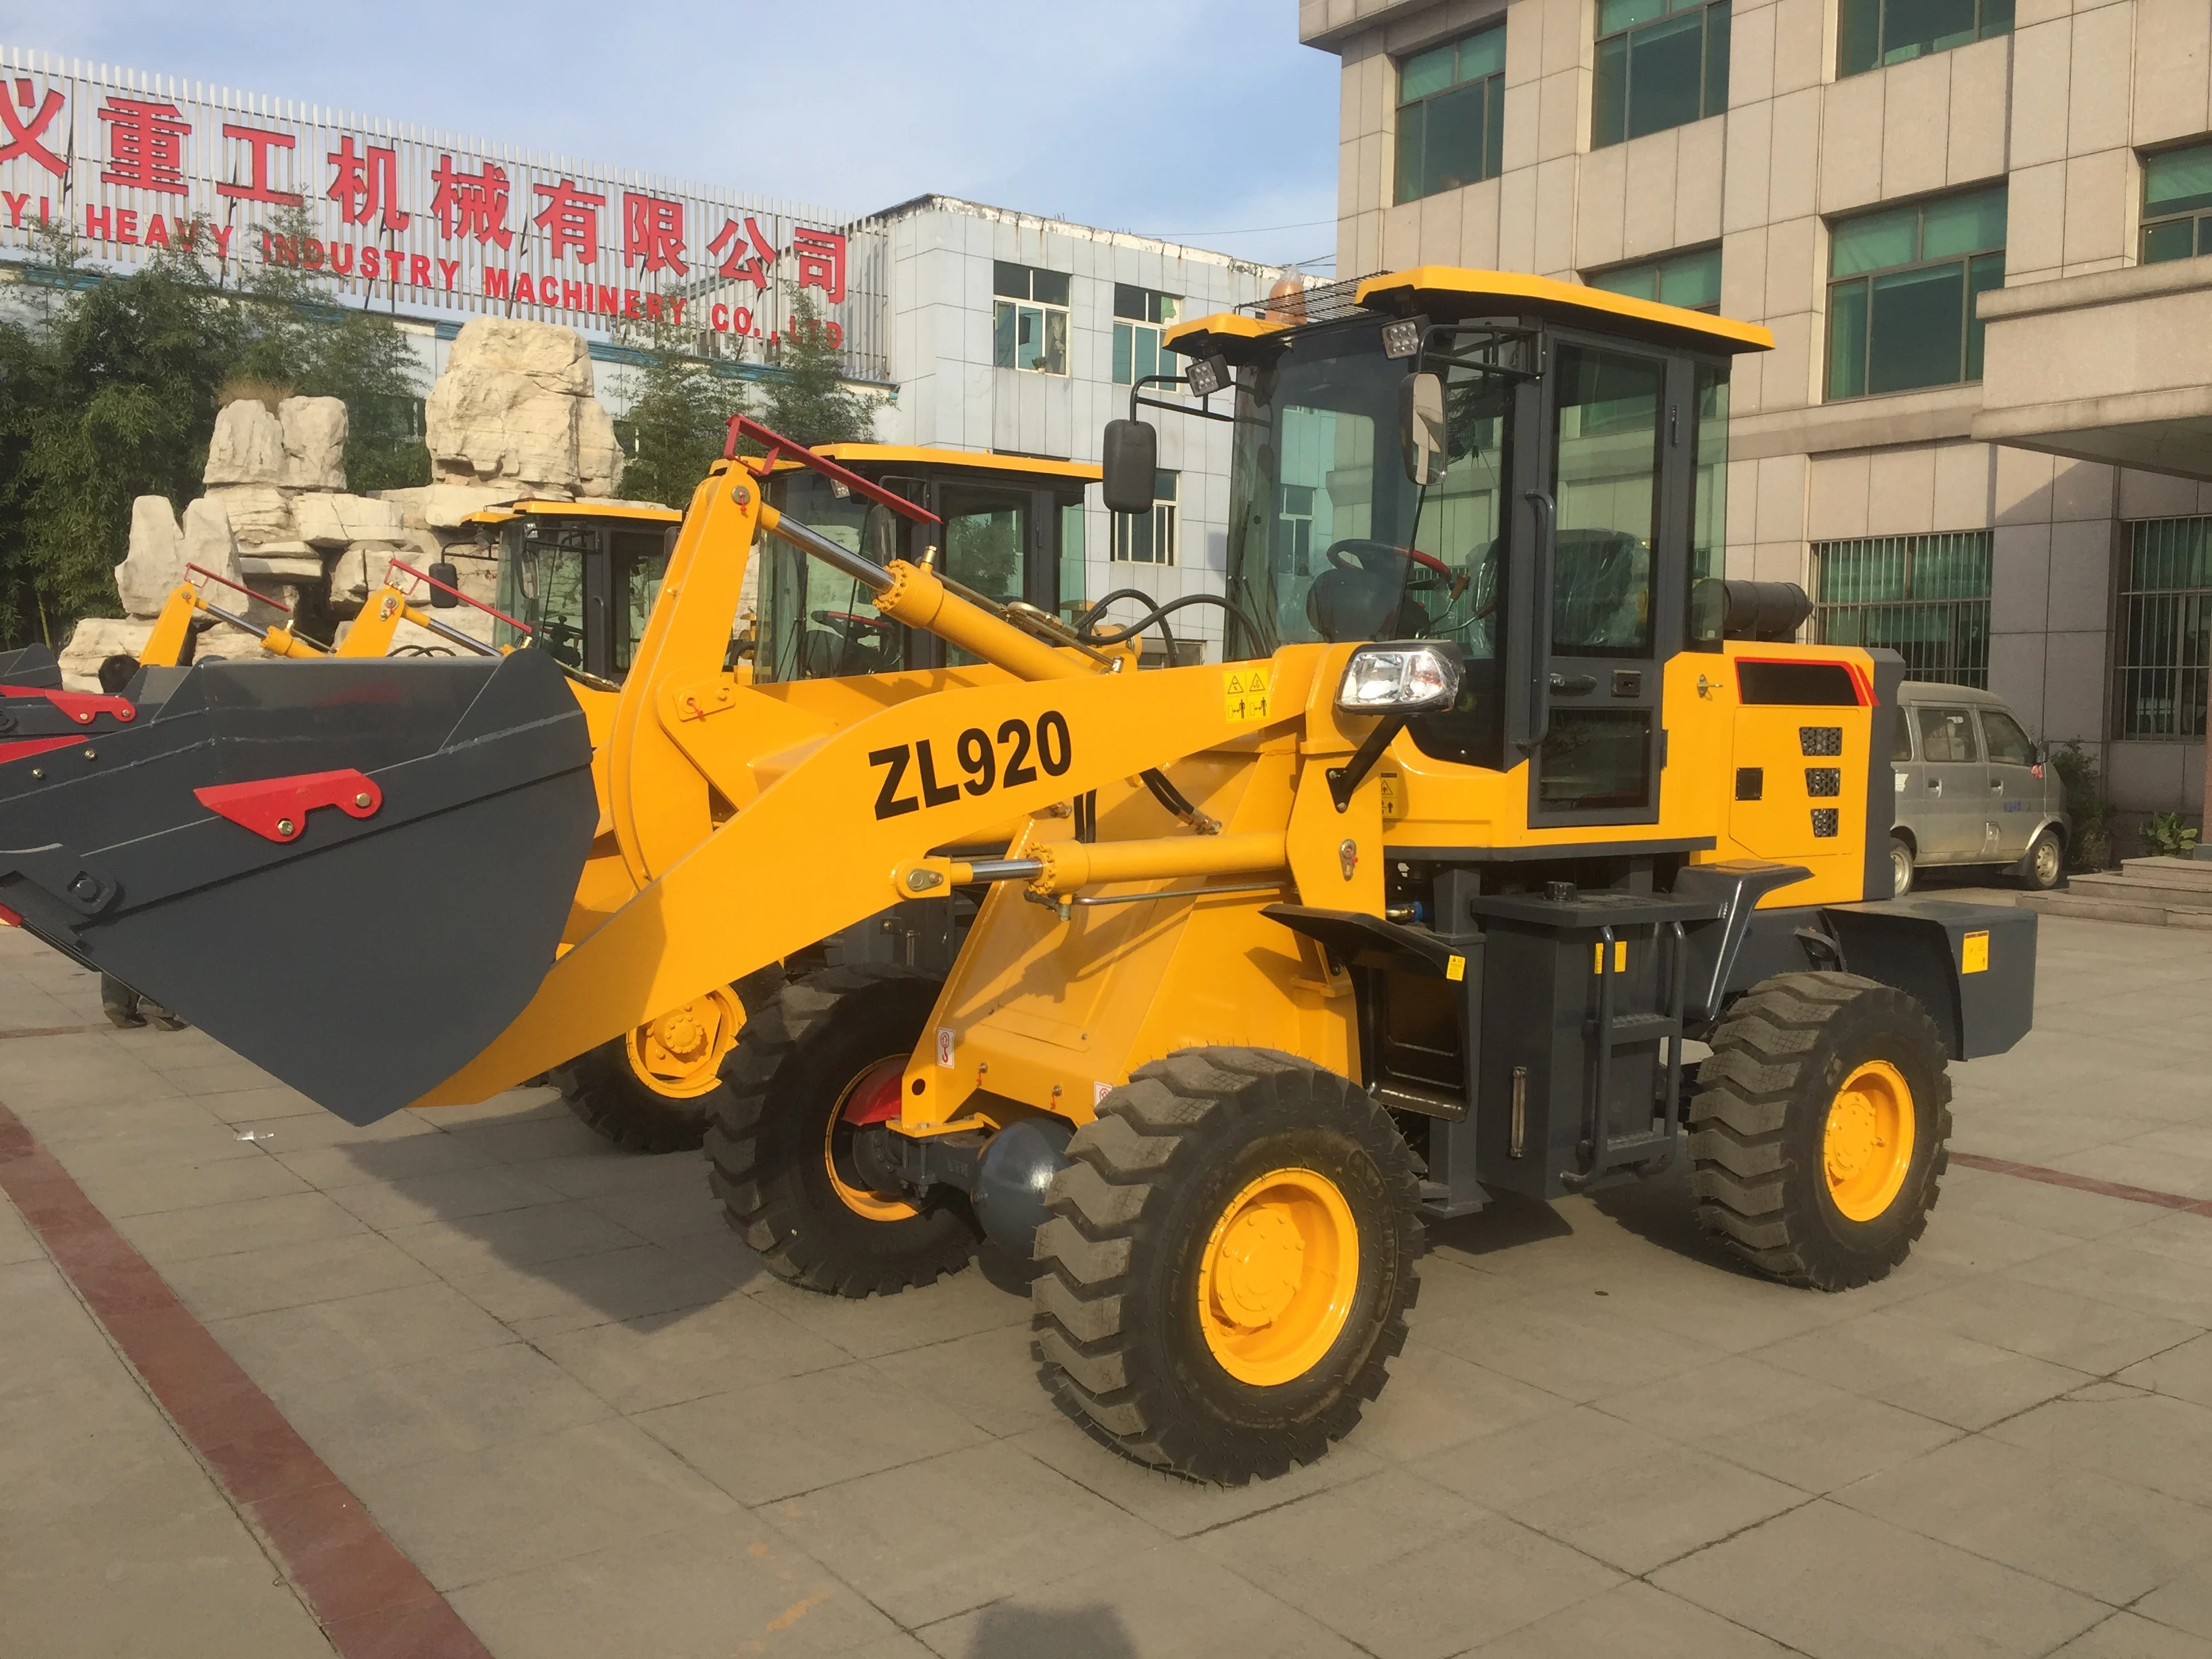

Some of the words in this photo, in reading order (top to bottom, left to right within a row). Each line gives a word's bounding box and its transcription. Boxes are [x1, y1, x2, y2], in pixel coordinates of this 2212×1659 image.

[0, 78, 846, 304] 义重工机械有限公司
[1, 190, 49, 228] YI
[85, 203, 234, 258] HEAVY
[262, 230, 460, 289] INDUSTRY
[484, 266, 687, 325] MACHINERY
[868, 710, 1072, 821] ZL920
